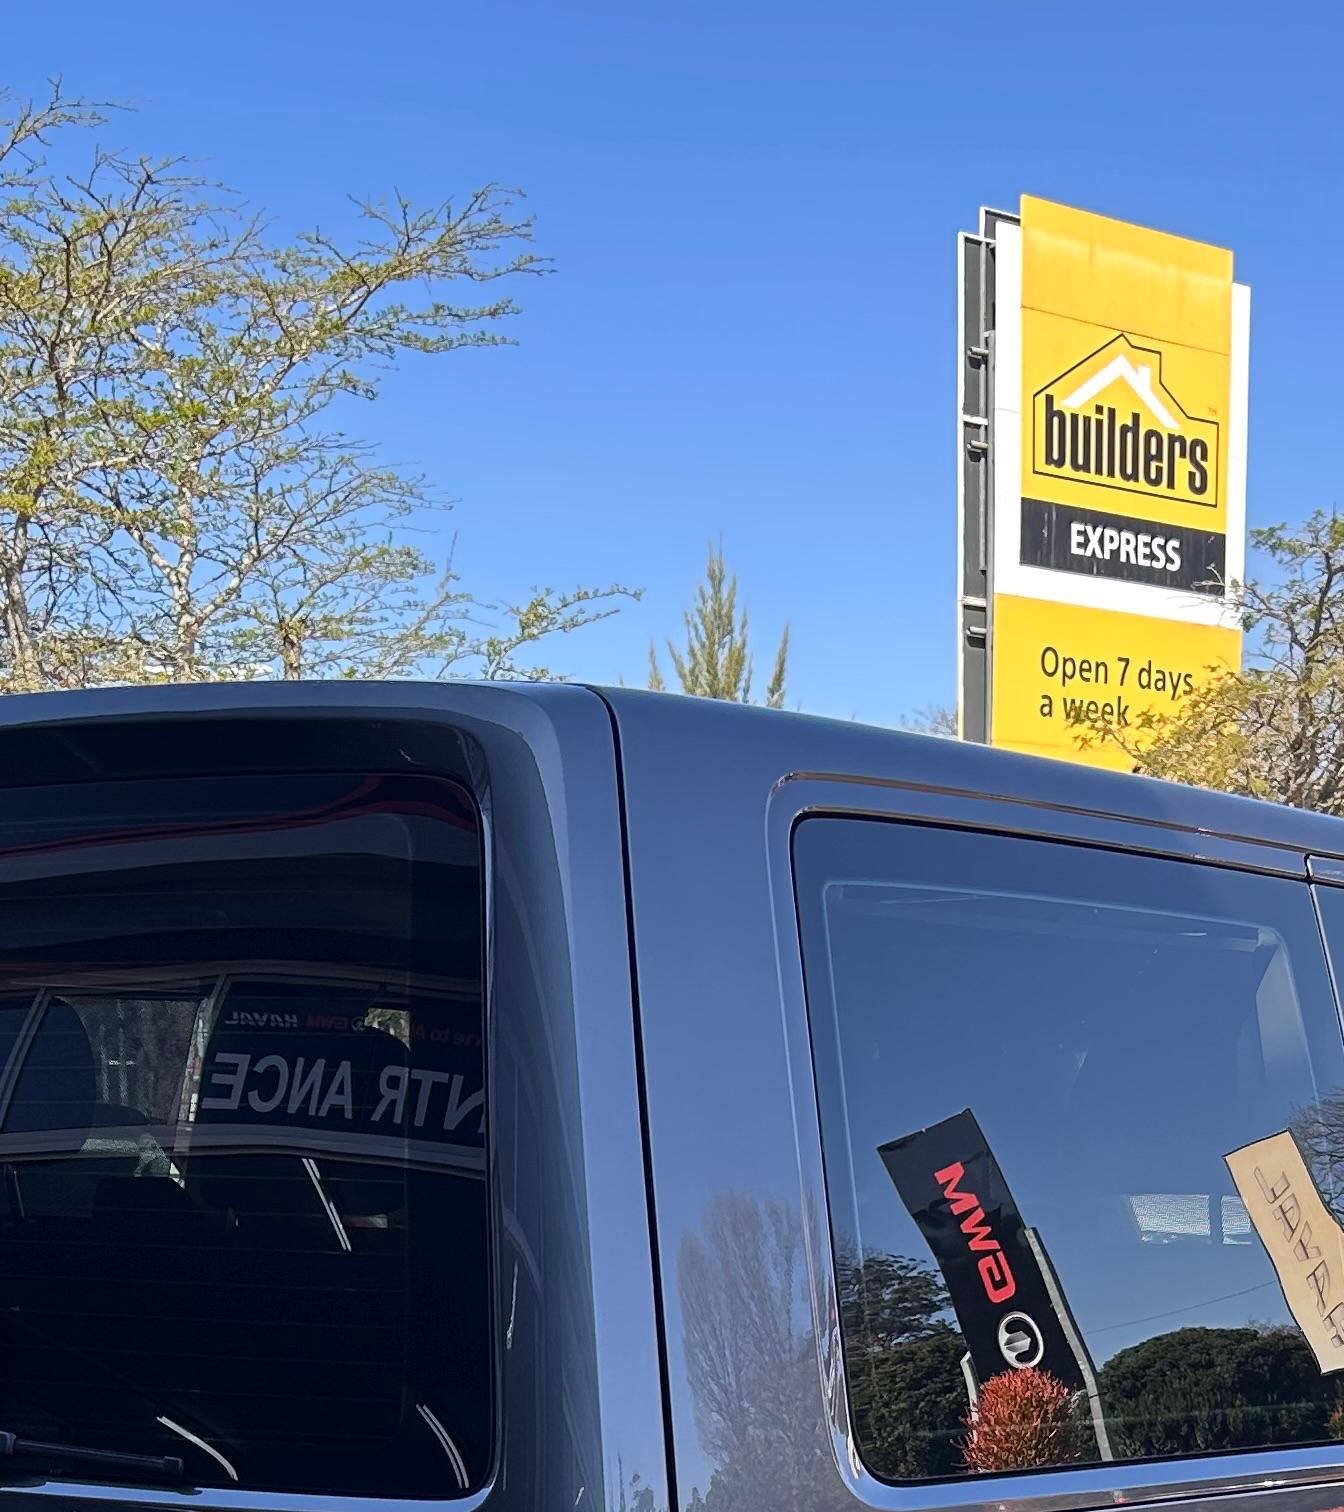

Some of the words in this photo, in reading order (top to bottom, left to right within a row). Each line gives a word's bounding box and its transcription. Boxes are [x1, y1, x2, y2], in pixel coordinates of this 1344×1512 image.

[1045, 394, 1208, 495] builders
[1070, 521, 1181, 572] EXPRESS
[1041, 646, 1108, 687] Open
[1117, 657, 1130, 686] 7
[1138, 660, 1194, 700] days
[1039, 694, 1053, 718] a
[1063, 696, 1130, 727] week
